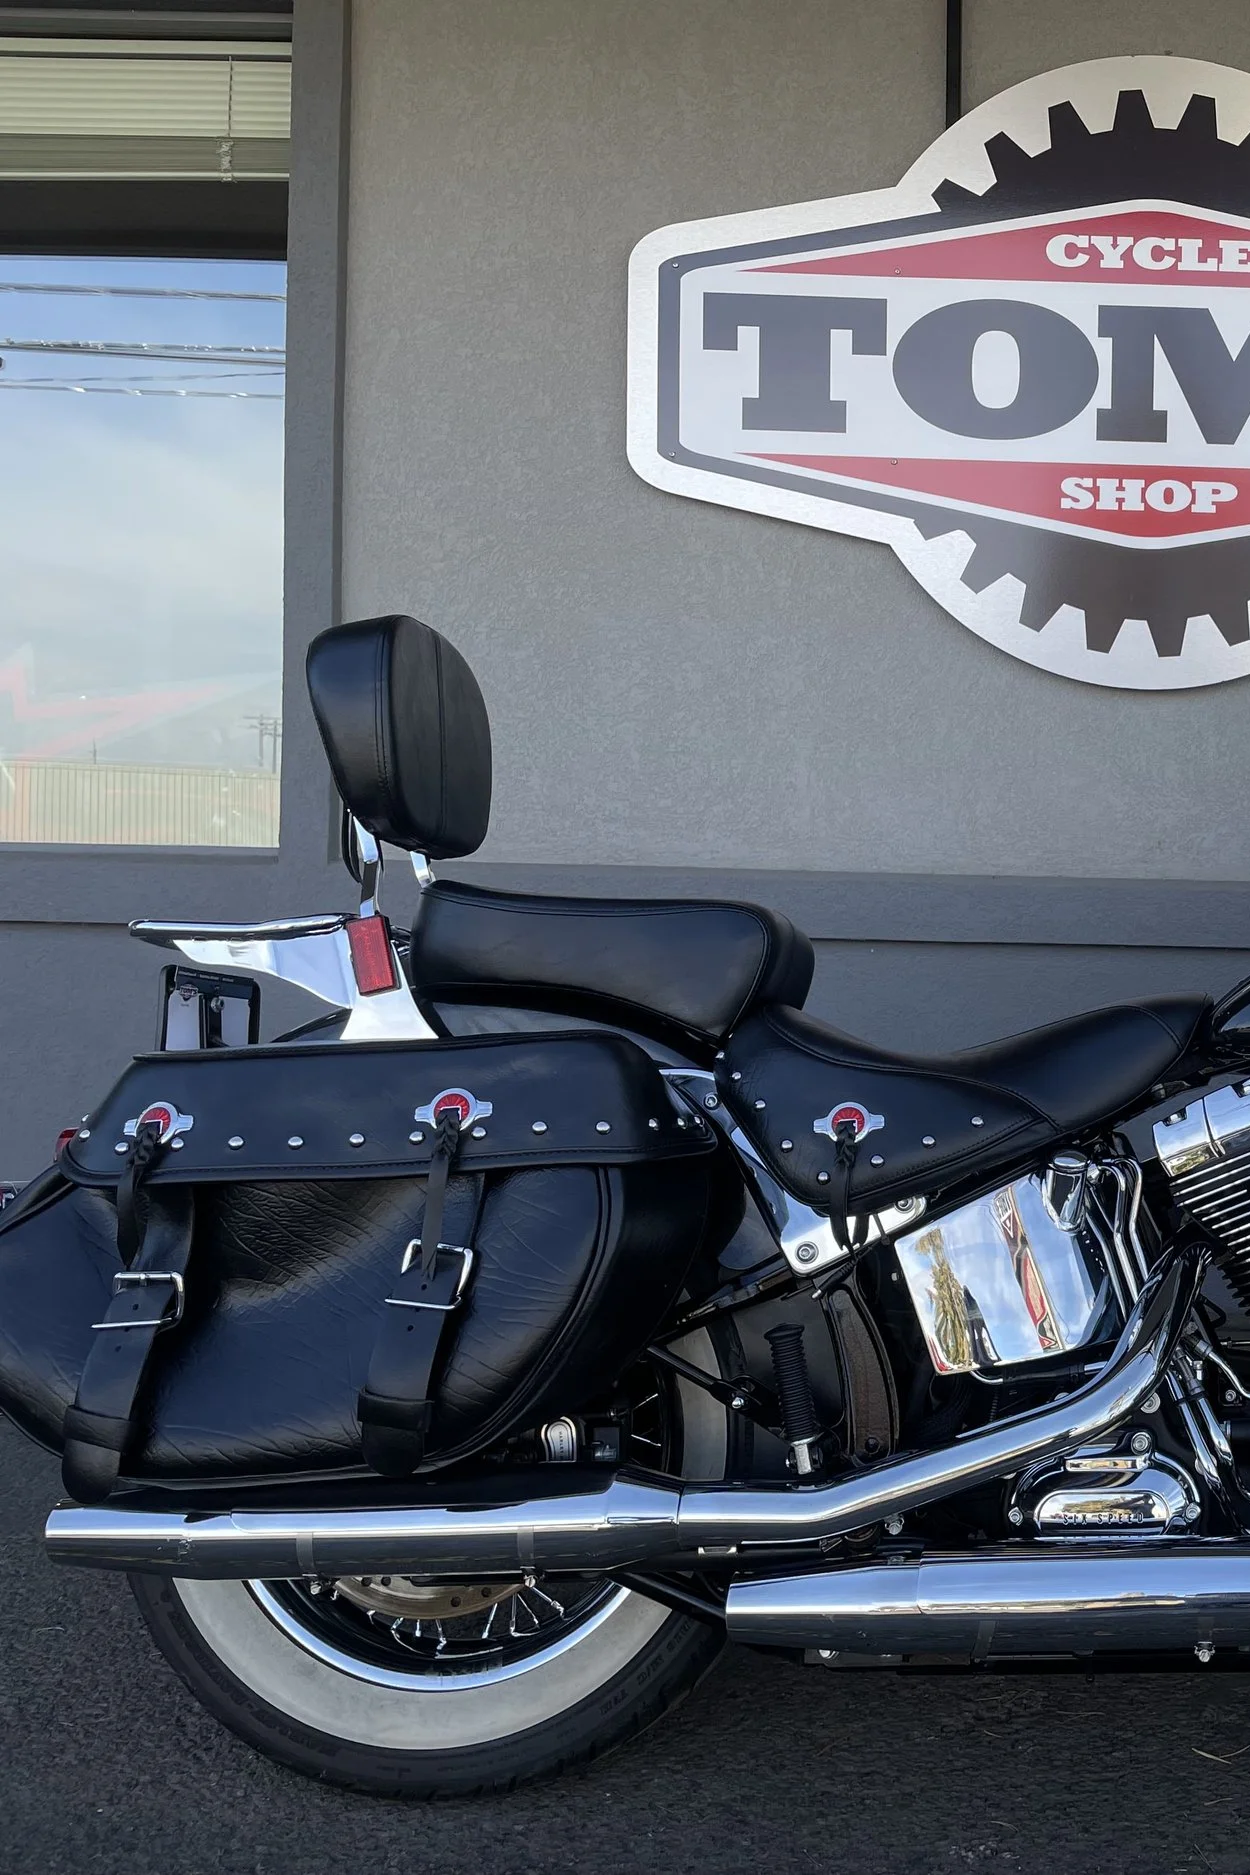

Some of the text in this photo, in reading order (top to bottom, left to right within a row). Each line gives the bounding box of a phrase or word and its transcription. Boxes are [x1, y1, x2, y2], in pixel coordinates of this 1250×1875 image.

[1060, 475, 1238, 514] SHOP
[1062, 1512, 1144, 1525] SIX SPEED
